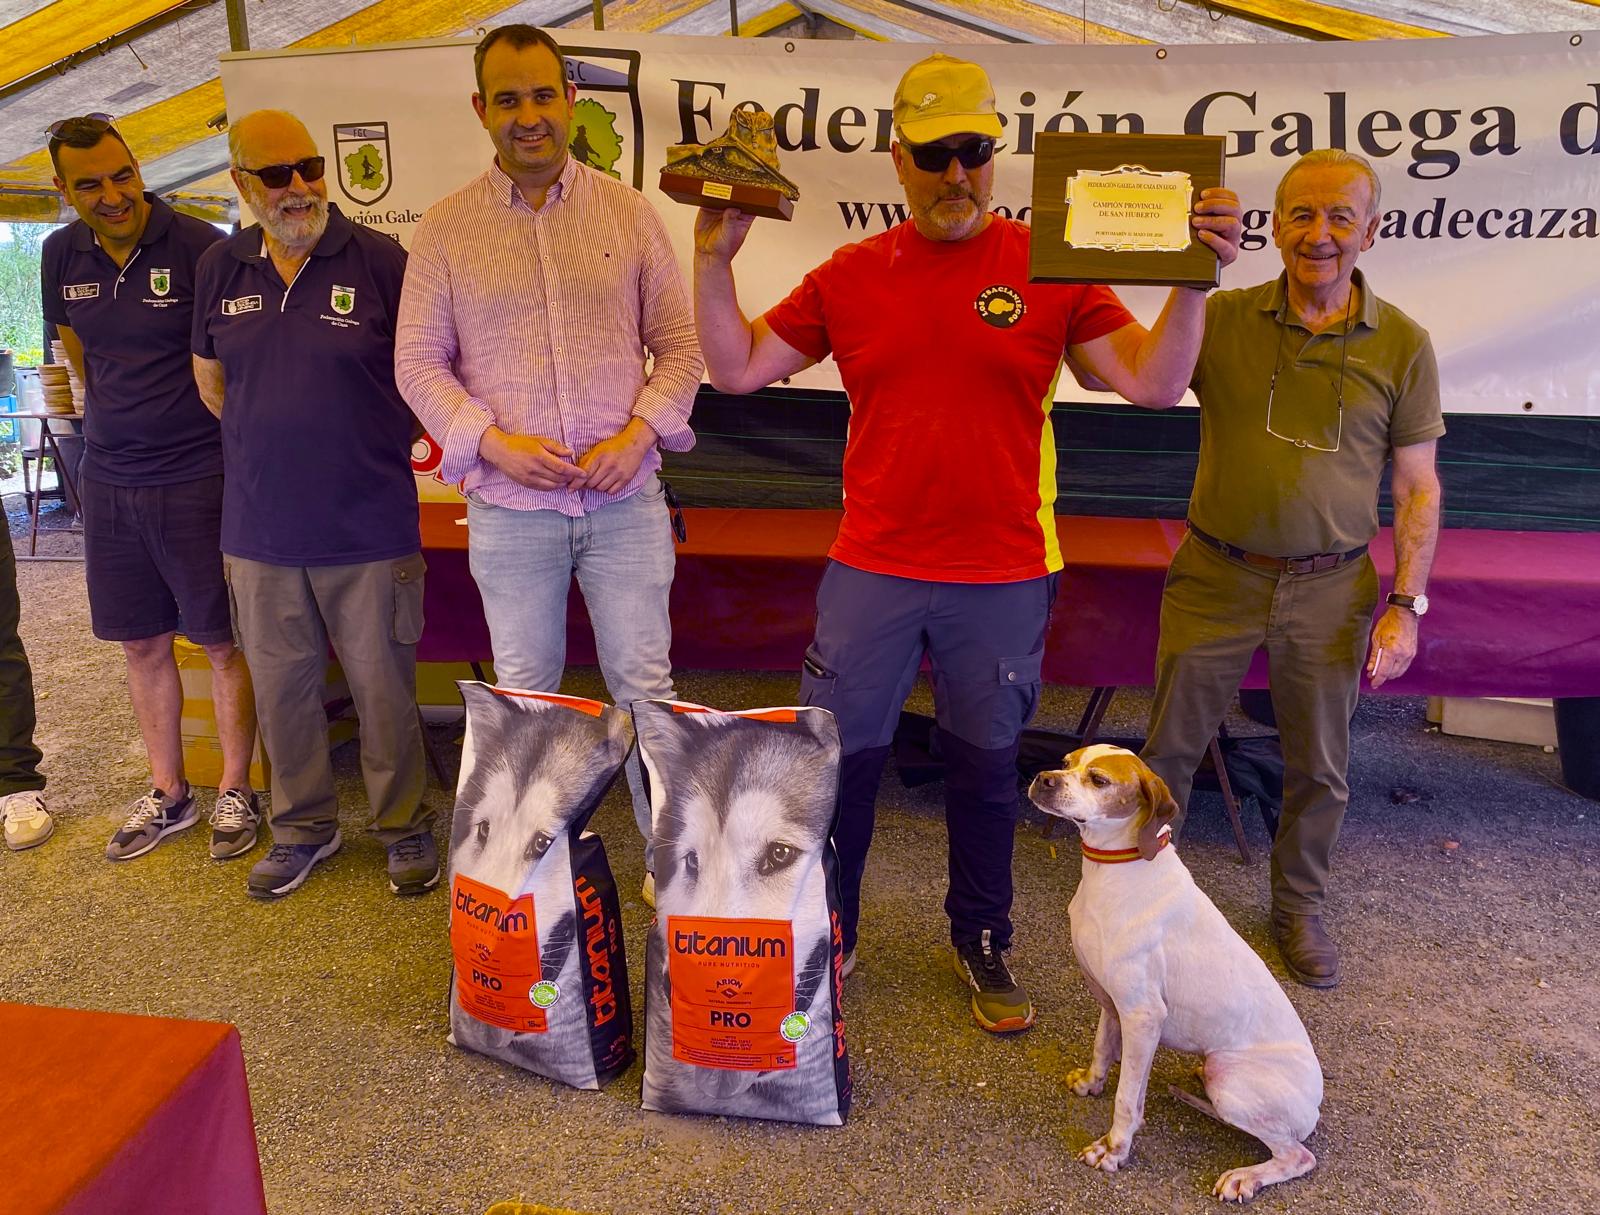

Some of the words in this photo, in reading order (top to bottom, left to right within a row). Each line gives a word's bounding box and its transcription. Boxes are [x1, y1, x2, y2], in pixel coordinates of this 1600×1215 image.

[565, 60, 587, 82] GC
[353, 128, 368, 138] FGC
[1183, 90, 1522, 180] Galega
[1093, 201, 1124, 209] CAMPIÓN
[1124, 202, 1164, 210] PROVINCIAL
[385, 209, 424, 225] Gale
[1125, 211, 1160, 219] HUBERTO
[978, 301, 989, 317] LOS
[575, 875, 617, 1028] titanium
[674, 930, 786, 958] titanium
[720, 961, 760, 969] NUTRITION
[472, 968, 503, 992] PRO
[716, 978, 743, 989] ARION
[710, 1010, 752, 1029] PRO
